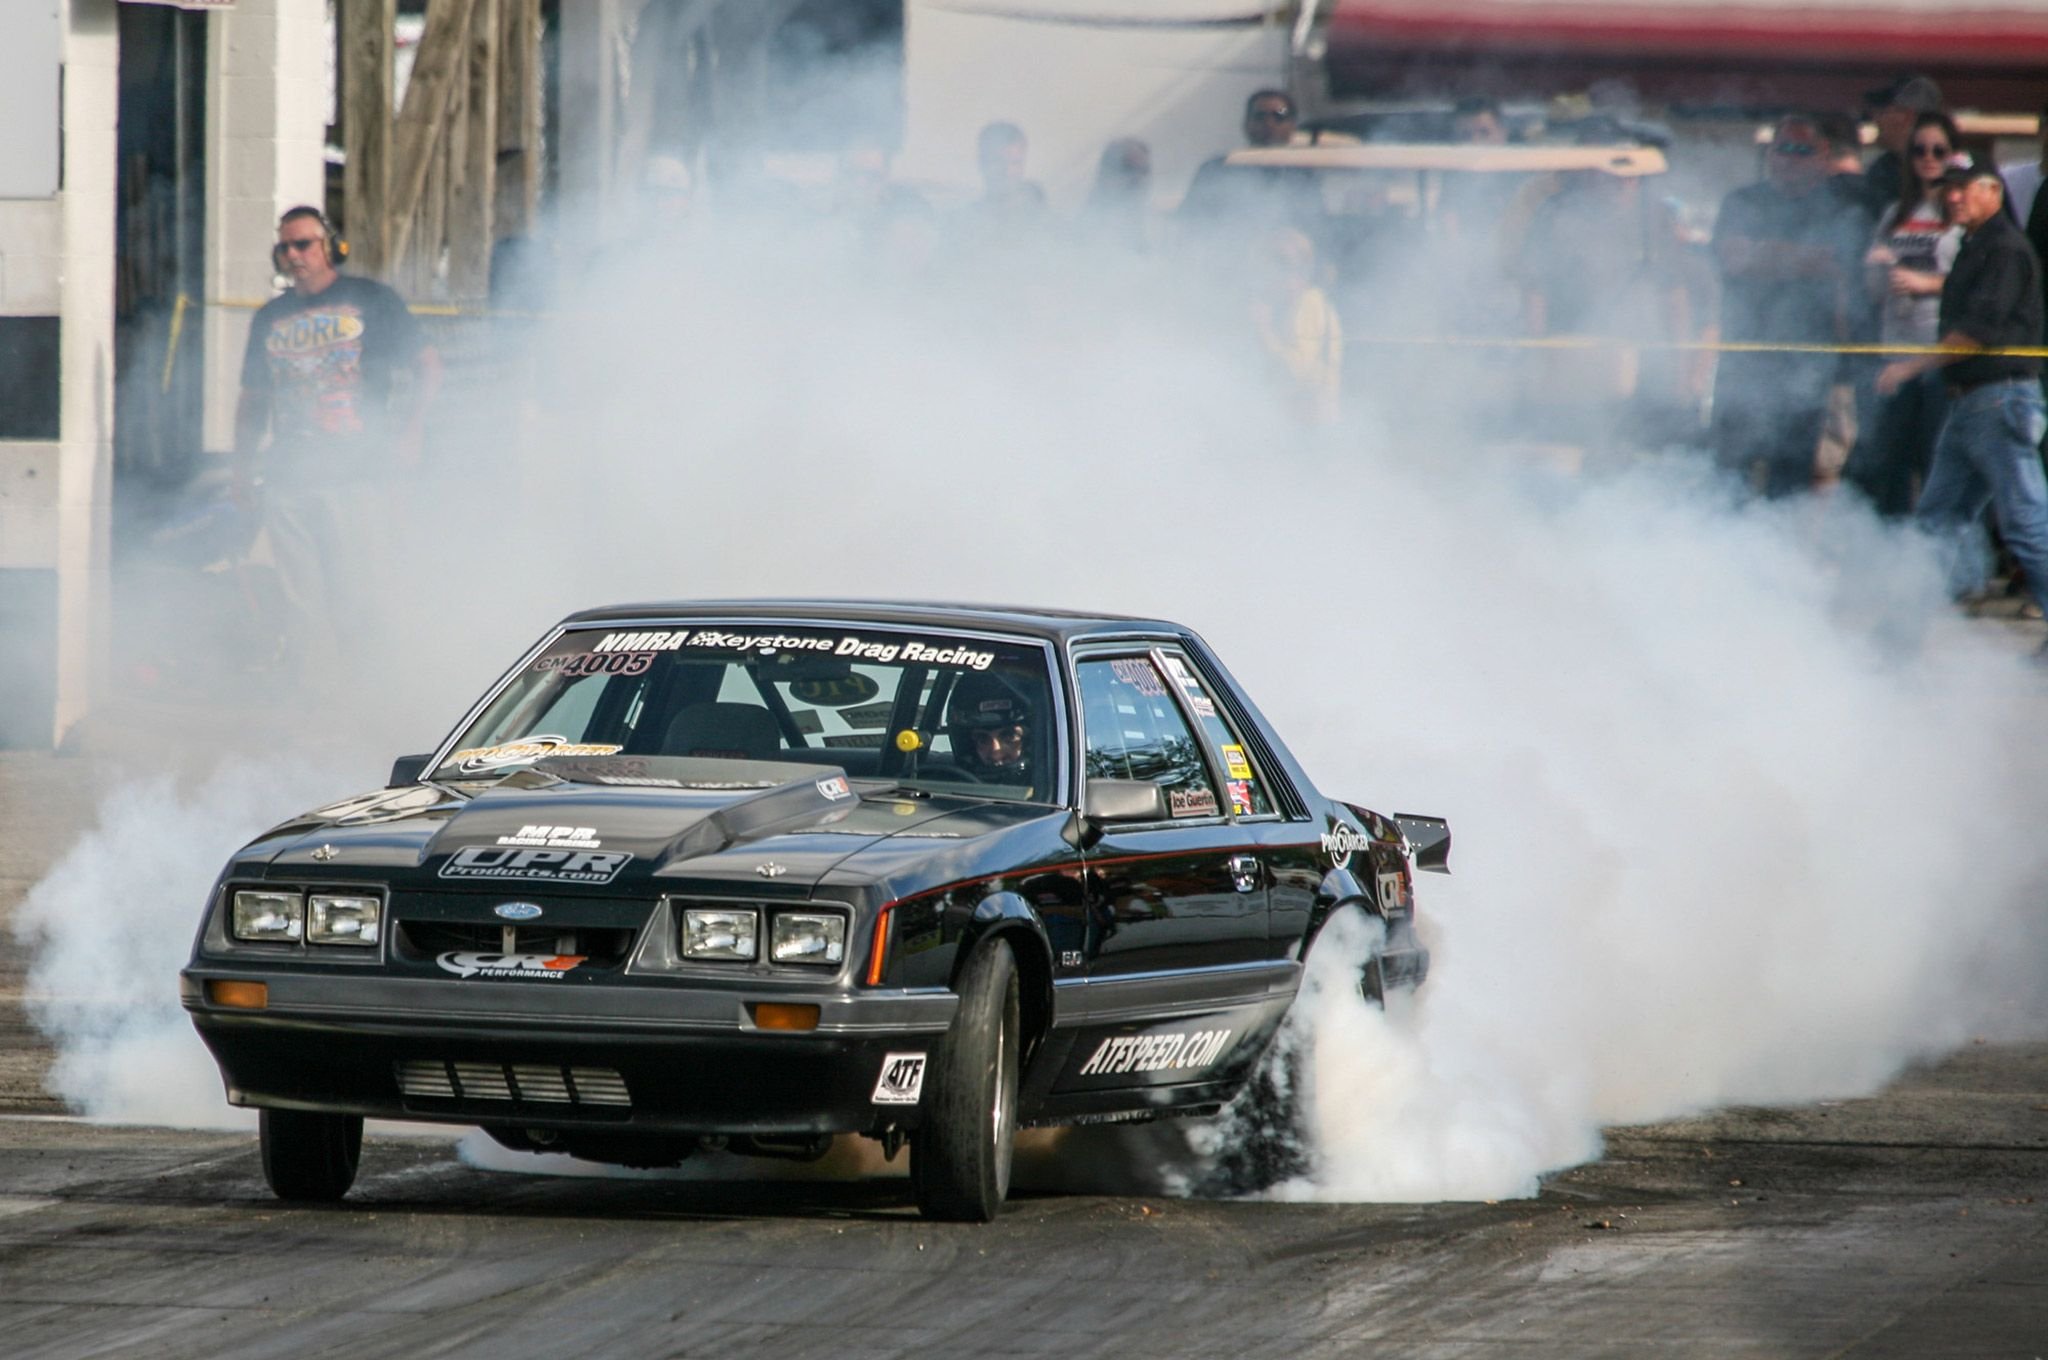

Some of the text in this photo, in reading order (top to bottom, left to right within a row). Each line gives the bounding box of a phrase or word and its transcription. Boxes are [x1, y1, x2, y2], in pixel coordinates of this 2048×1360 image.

[593, 631, 995, 670] NMRA Keystone Drag Racing
[516, 825, 597, 840] MPR
[1320, 832, 1370, 853] PROCHARGER
[453, 848, 626, 873] UPR
[444, 865, 609, 881] Products.com
[480, 968, 565, 979] PERFORMANCE
[1080, 1029, 1232, 1075] ATFSPEED.COM
[887, 1059, 924, 1088] ATF
